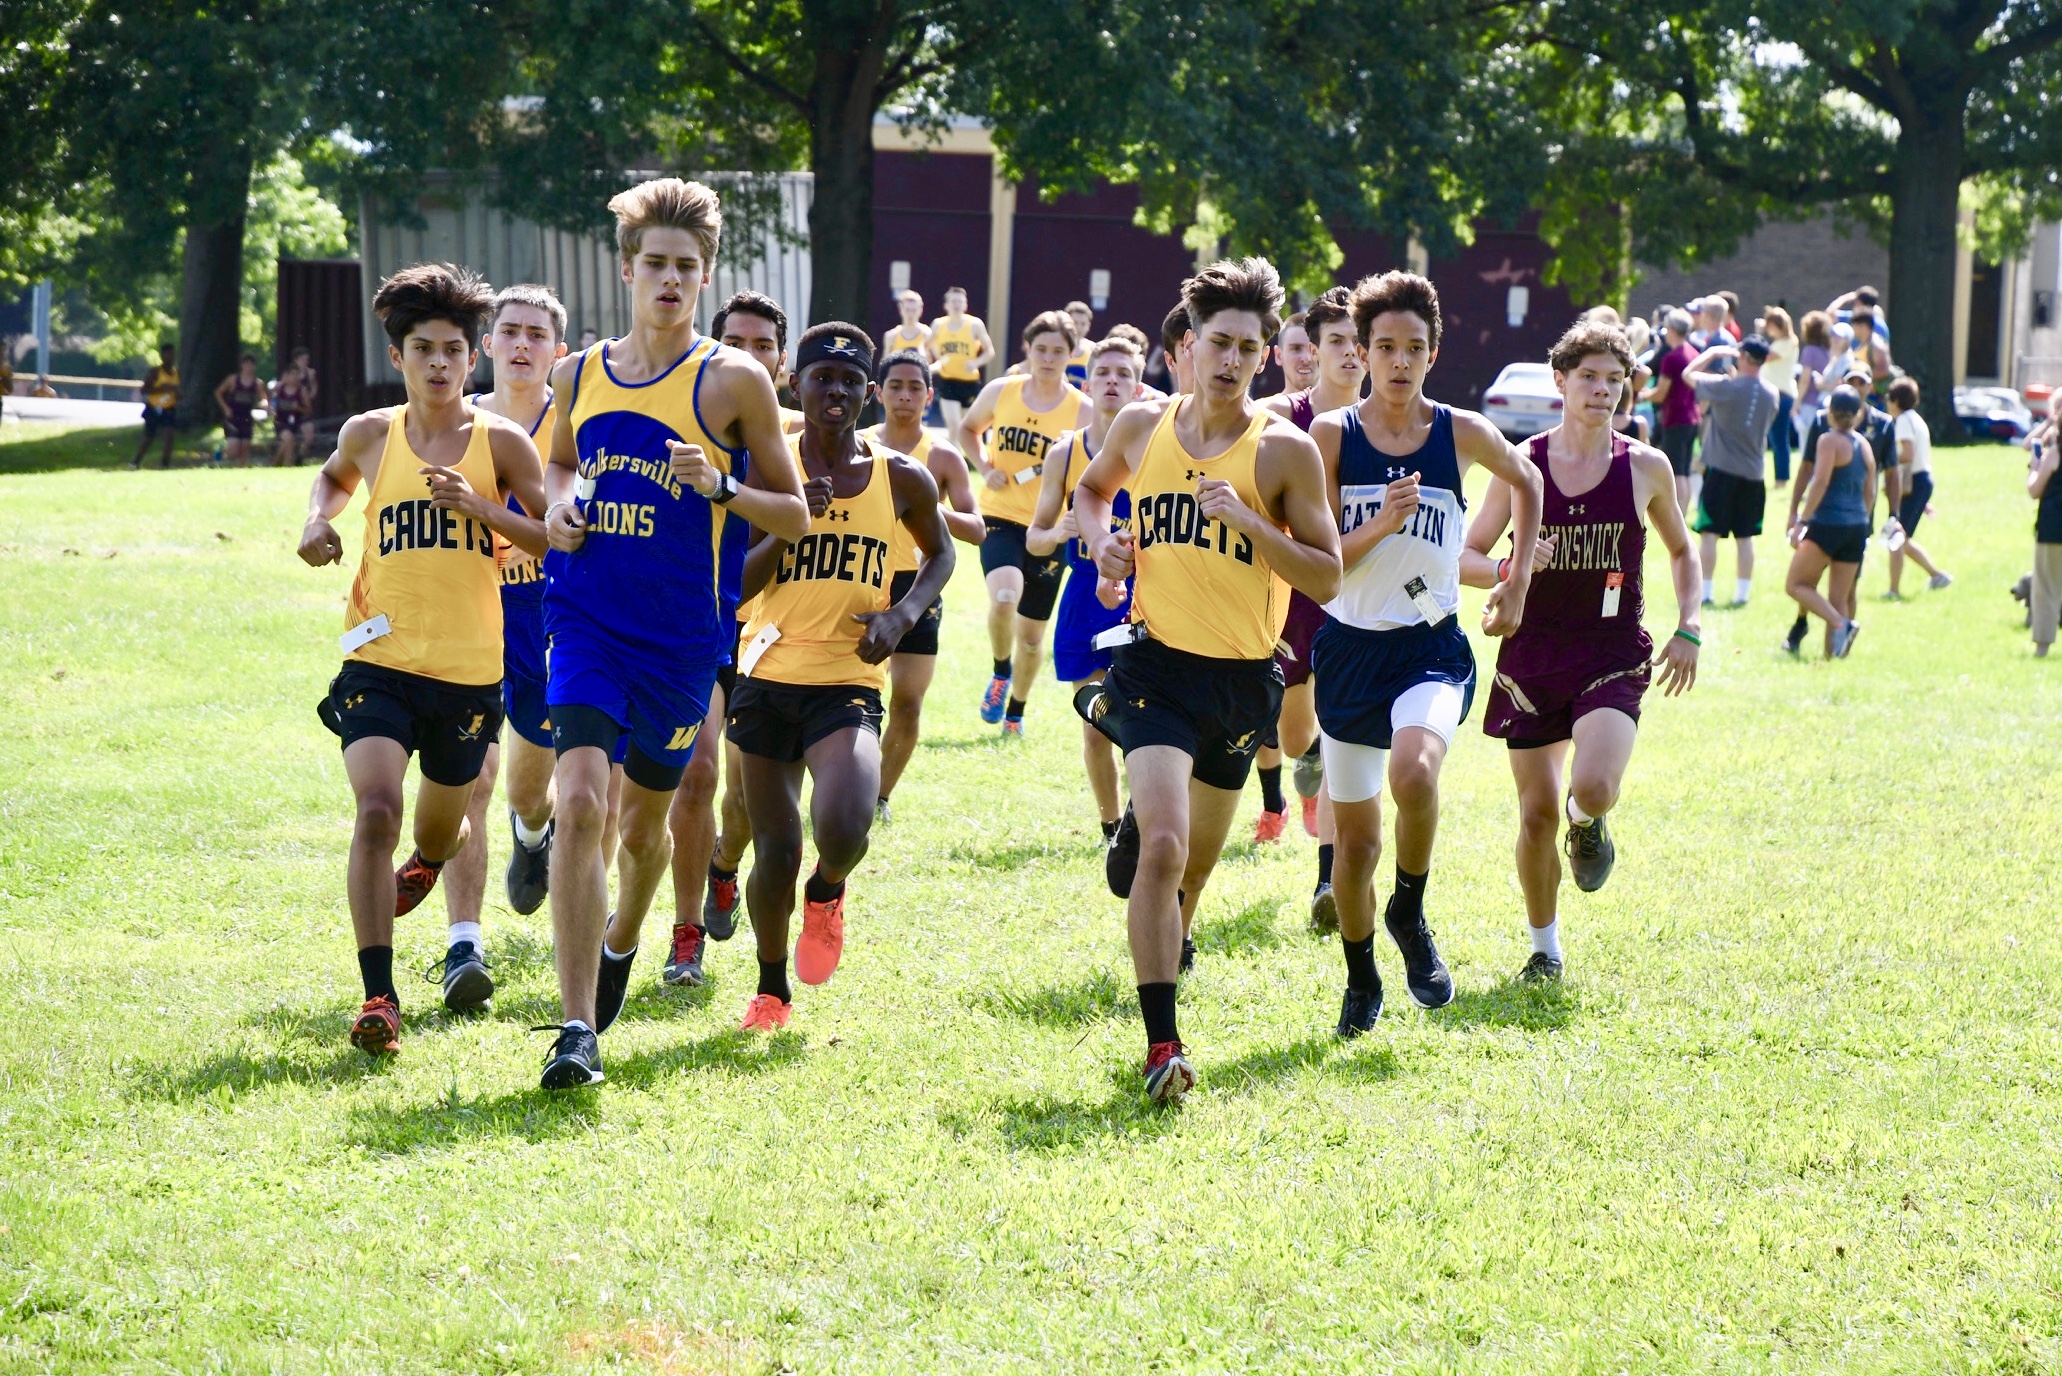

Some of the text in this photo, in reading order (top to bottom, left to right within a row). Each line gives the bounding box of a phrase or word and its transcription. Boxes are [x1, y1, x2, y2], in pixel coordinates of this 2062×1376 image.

[998, 425, 1057, 460] CADET
[1341, 500, 1445, 548] CATTIN
[1540, 522, 1625, 570] UNSWICK
[499, 557, 546, 586] ION
[776, 532, 888, 590] CADETS
